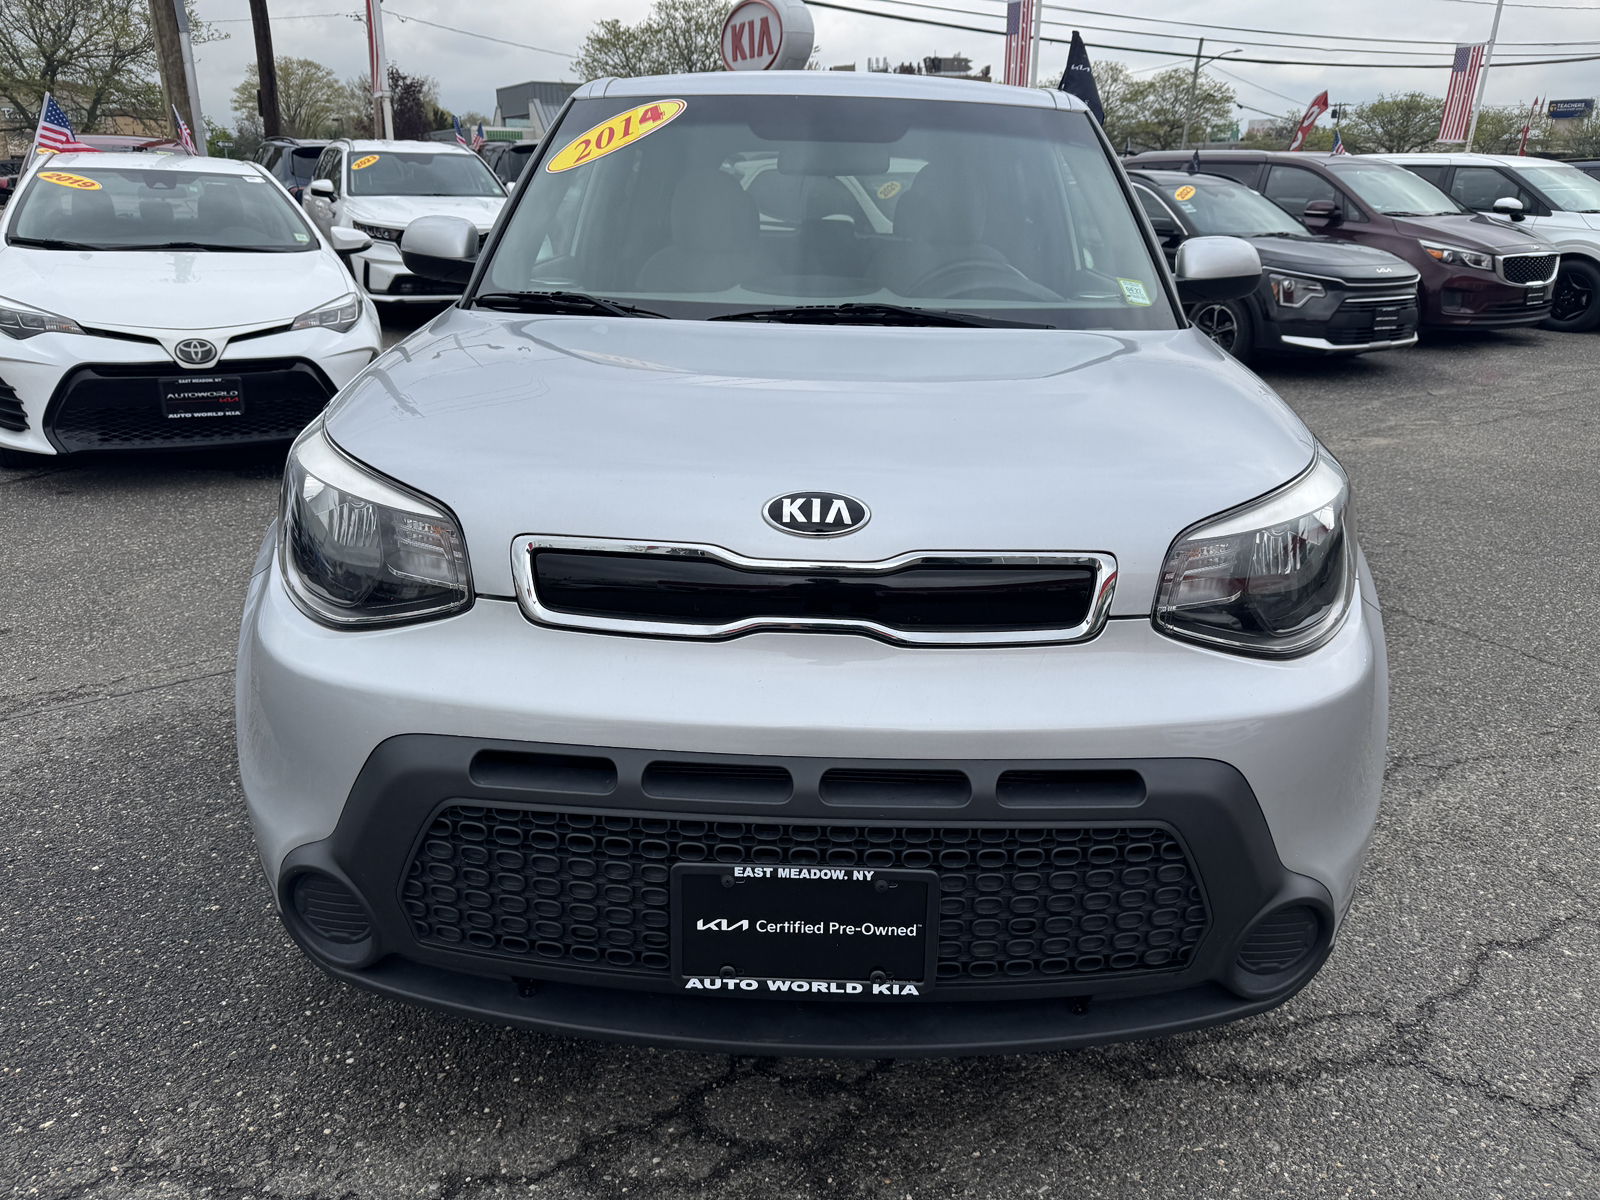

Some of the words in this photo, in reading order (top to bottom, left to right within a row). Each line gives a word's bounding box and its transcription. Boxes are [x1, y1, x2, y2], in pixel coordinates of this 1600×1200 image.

[730, 16, 774, 62] KIA
[573, 104, 666, 164] 2014
[42, 173, 96, 188] 2019
[167, 391, 238, 399] AUTOWORLD
[781, 497, 853, 525] KIA
[734, 866, 774, 878] EAST
[852, 869, 875, 881] NY
[696, 918, 749, 932] KIA
[755, 919, 824, 934] Certified
[684, 978, 759, 991] AUTO
[766, 979, 863, 994] WORLD
[872, 983, 920, 996] KIA
